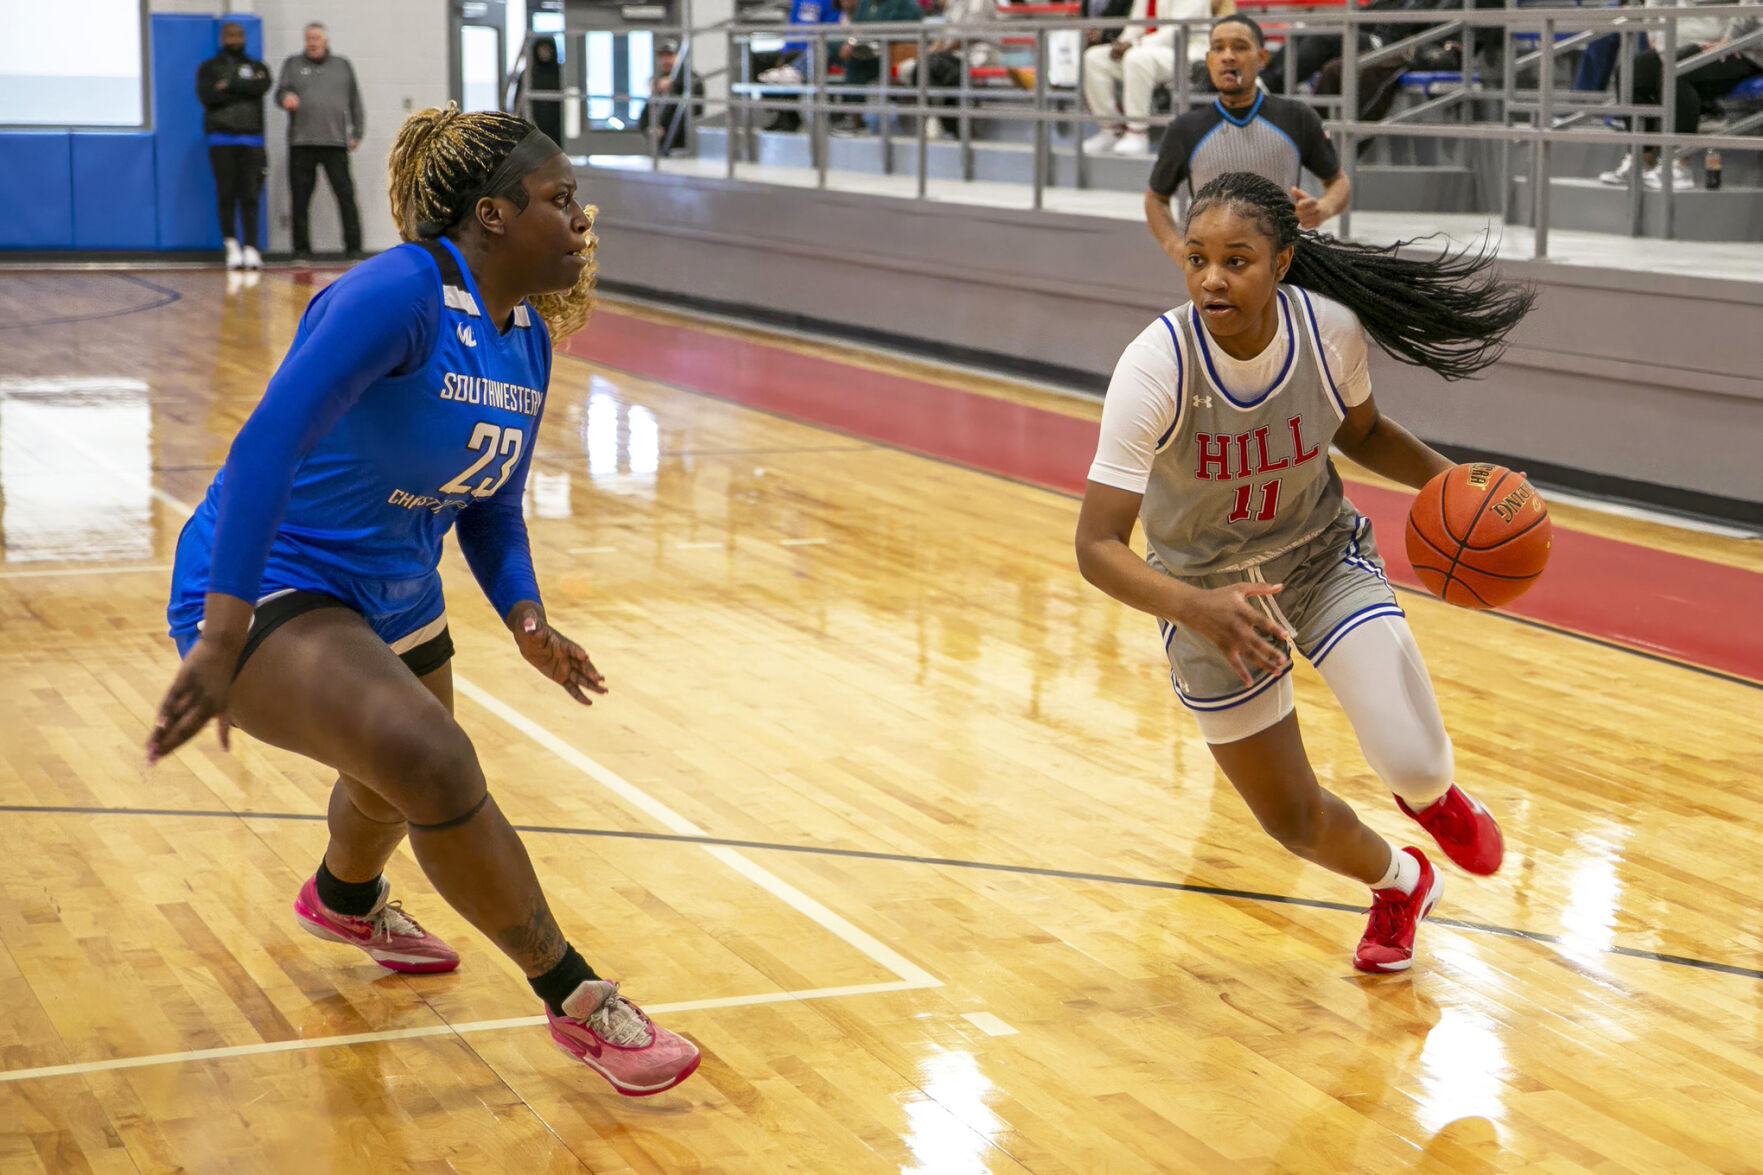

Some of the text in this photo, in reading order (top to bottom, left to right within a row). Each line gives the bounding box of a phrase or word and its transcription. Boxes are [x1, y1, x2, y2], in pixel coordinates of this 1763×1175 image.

[438, 421, 523, 497] 23
[1195, 414, 1320, 481] HILL
[1228, 478, 1282, 524] 11
